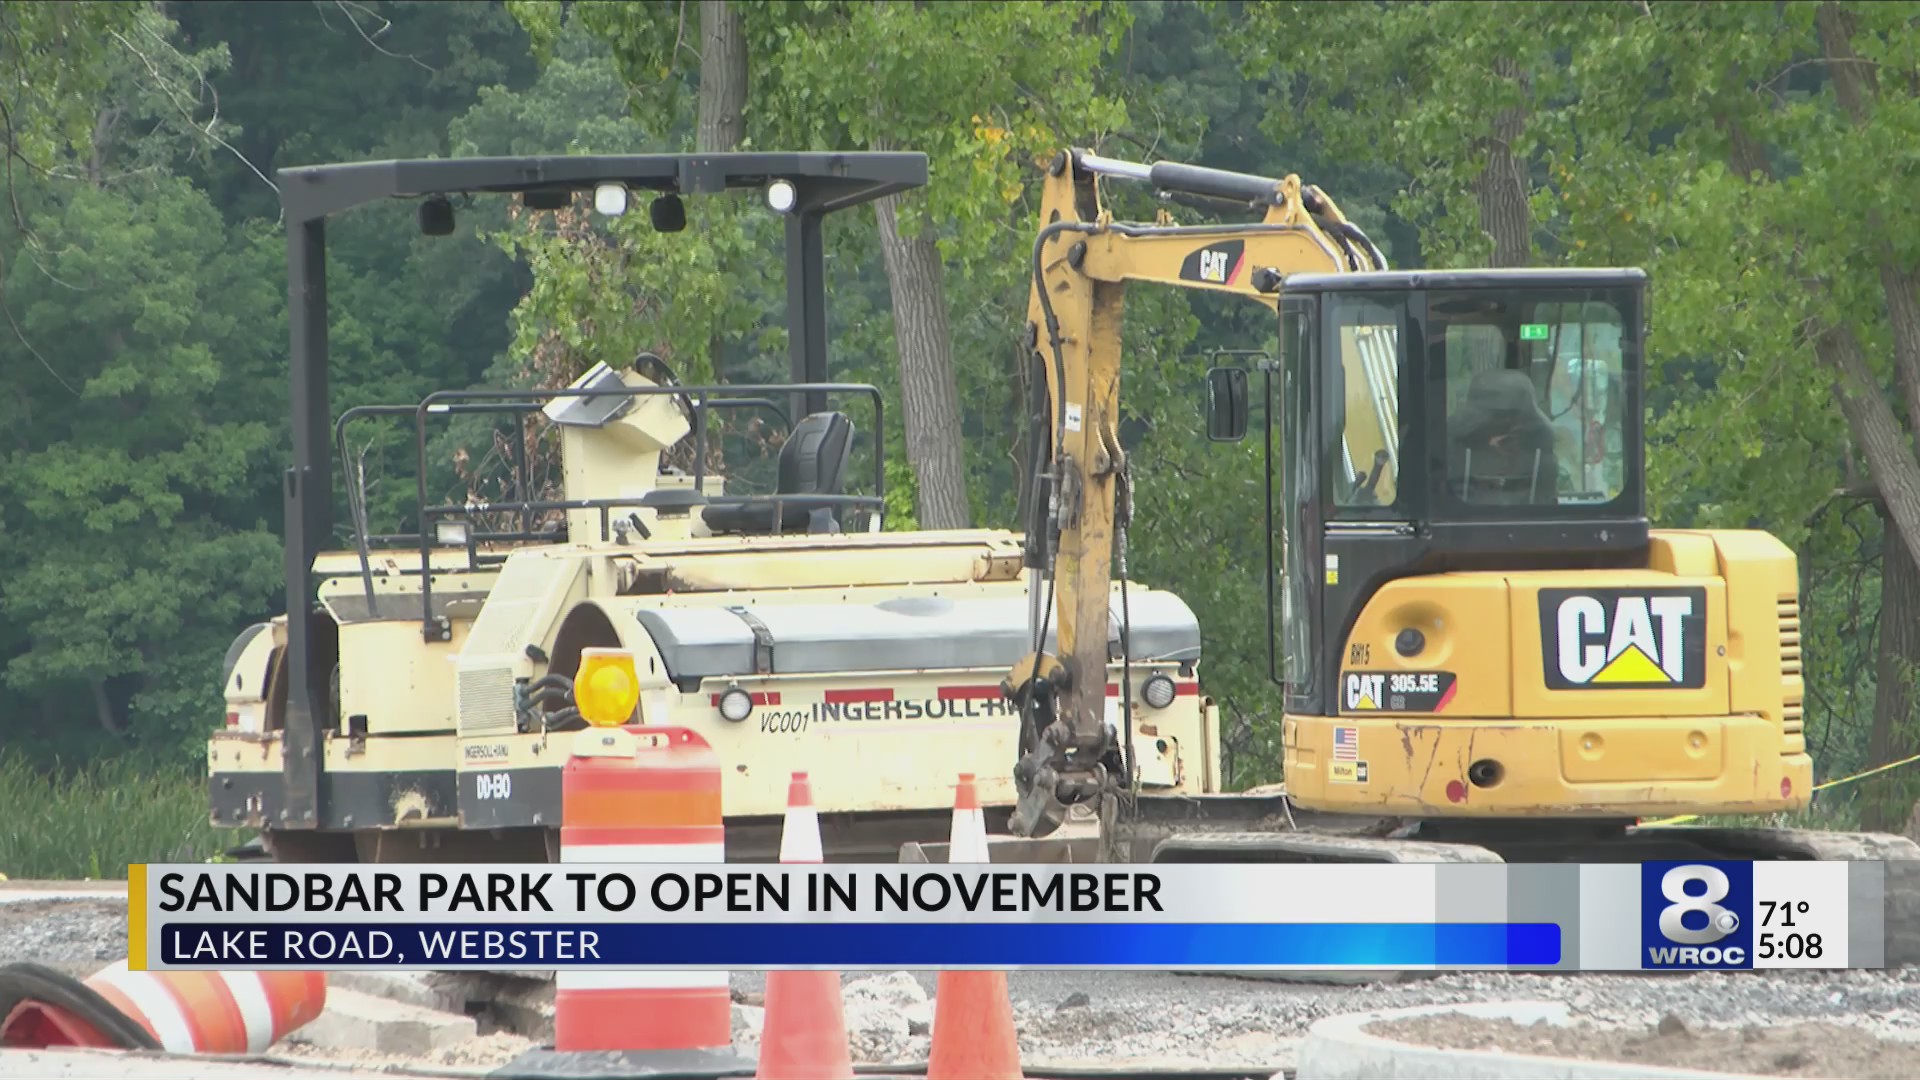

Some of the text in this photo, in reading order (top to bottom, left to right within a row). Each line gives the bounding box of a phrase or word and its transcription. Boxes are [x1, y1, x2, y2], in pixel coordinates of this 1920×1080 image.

[1200, 249, 1228, 282] CAT
[1557, 596, 1692, 684] CAT
[1347, 674, 1438, 709] CAT 305.5E
[761, 711, 809, 733] VC001
